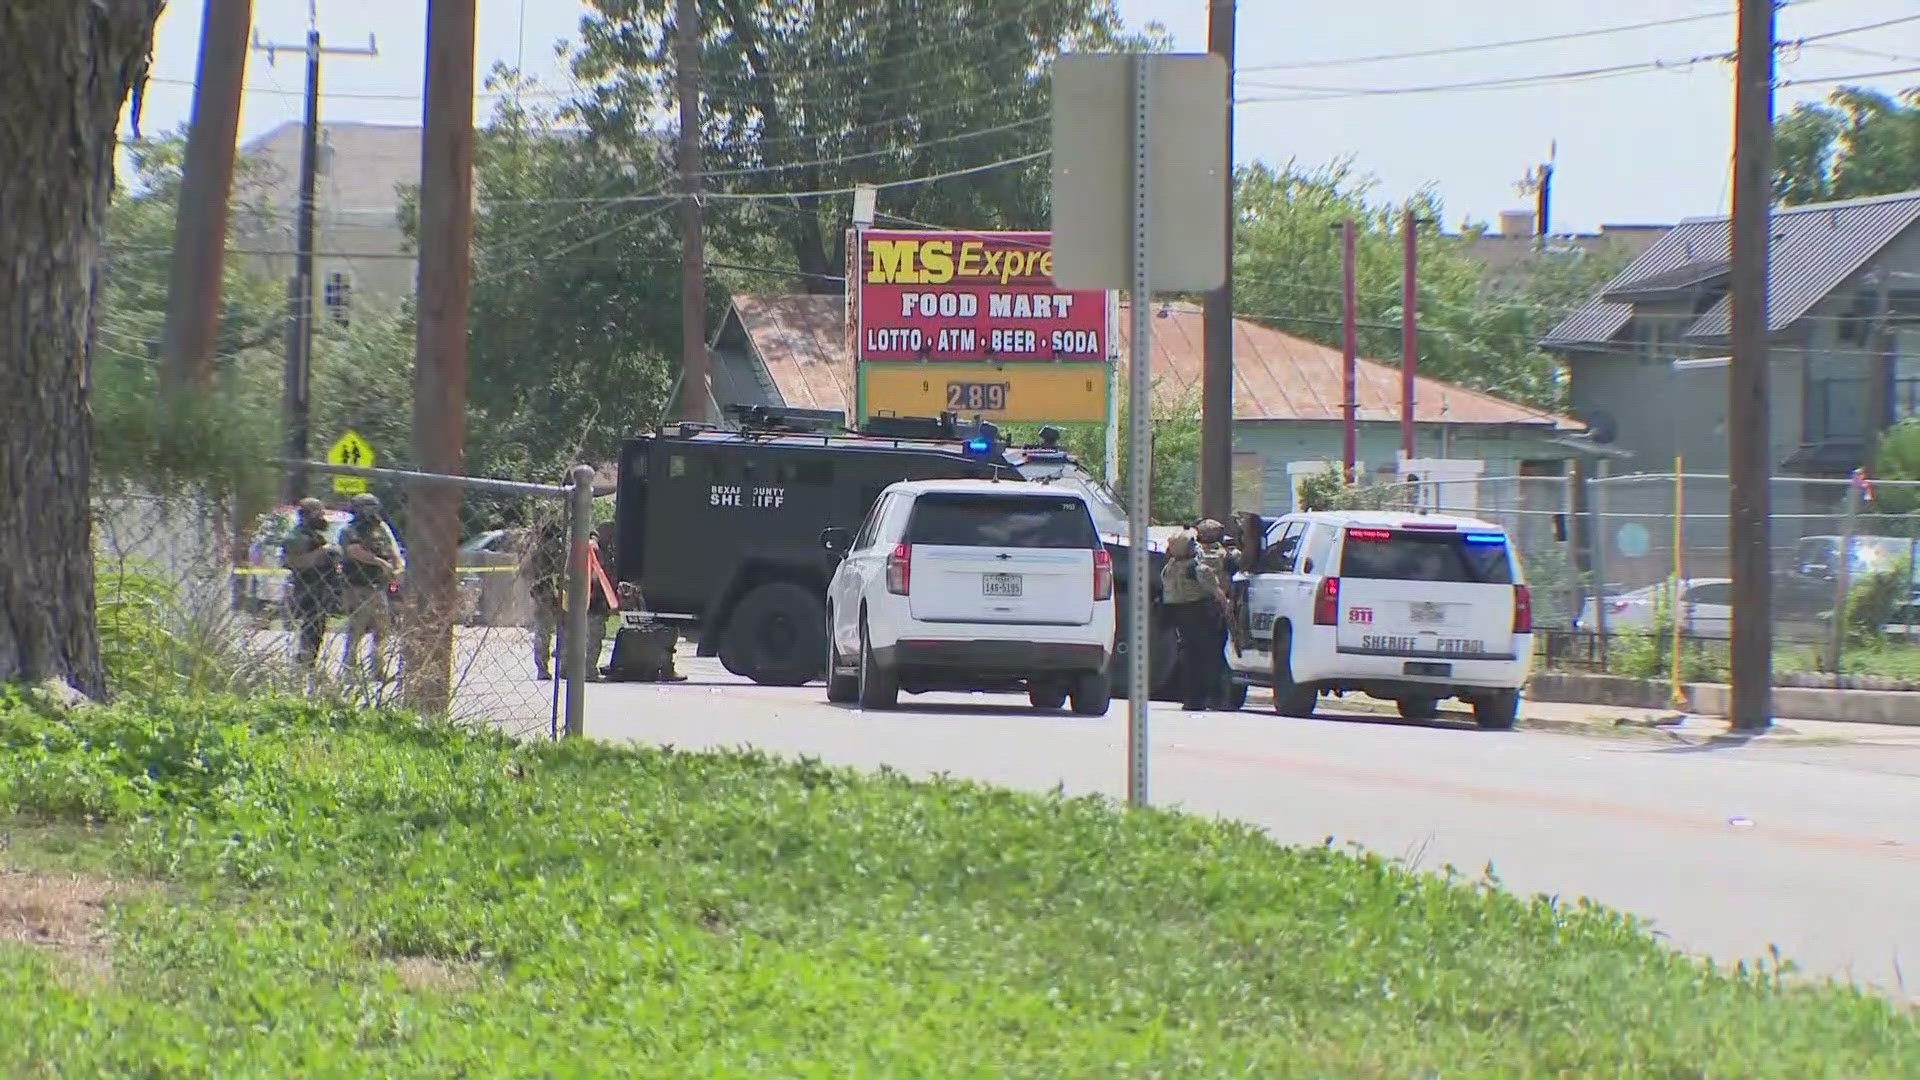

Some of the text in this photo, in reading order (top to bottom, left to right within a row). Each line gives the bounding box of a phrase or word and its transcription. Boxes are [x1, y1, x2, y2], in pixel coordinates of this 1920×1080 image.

[867, 240, 1054, 285] MS Expre
[901, 292, 1074, 319] FOOD MART
[867, 328, 1099, 354] LOTTO ATM BEER SODA
[709, 493, 785, 508] SHEIFF
[752, 487, 785, 497] OUNTY
[1348, 609, 1373, 622] 911
[1362, 635, 1486, 652] SHERIFF PATROL
